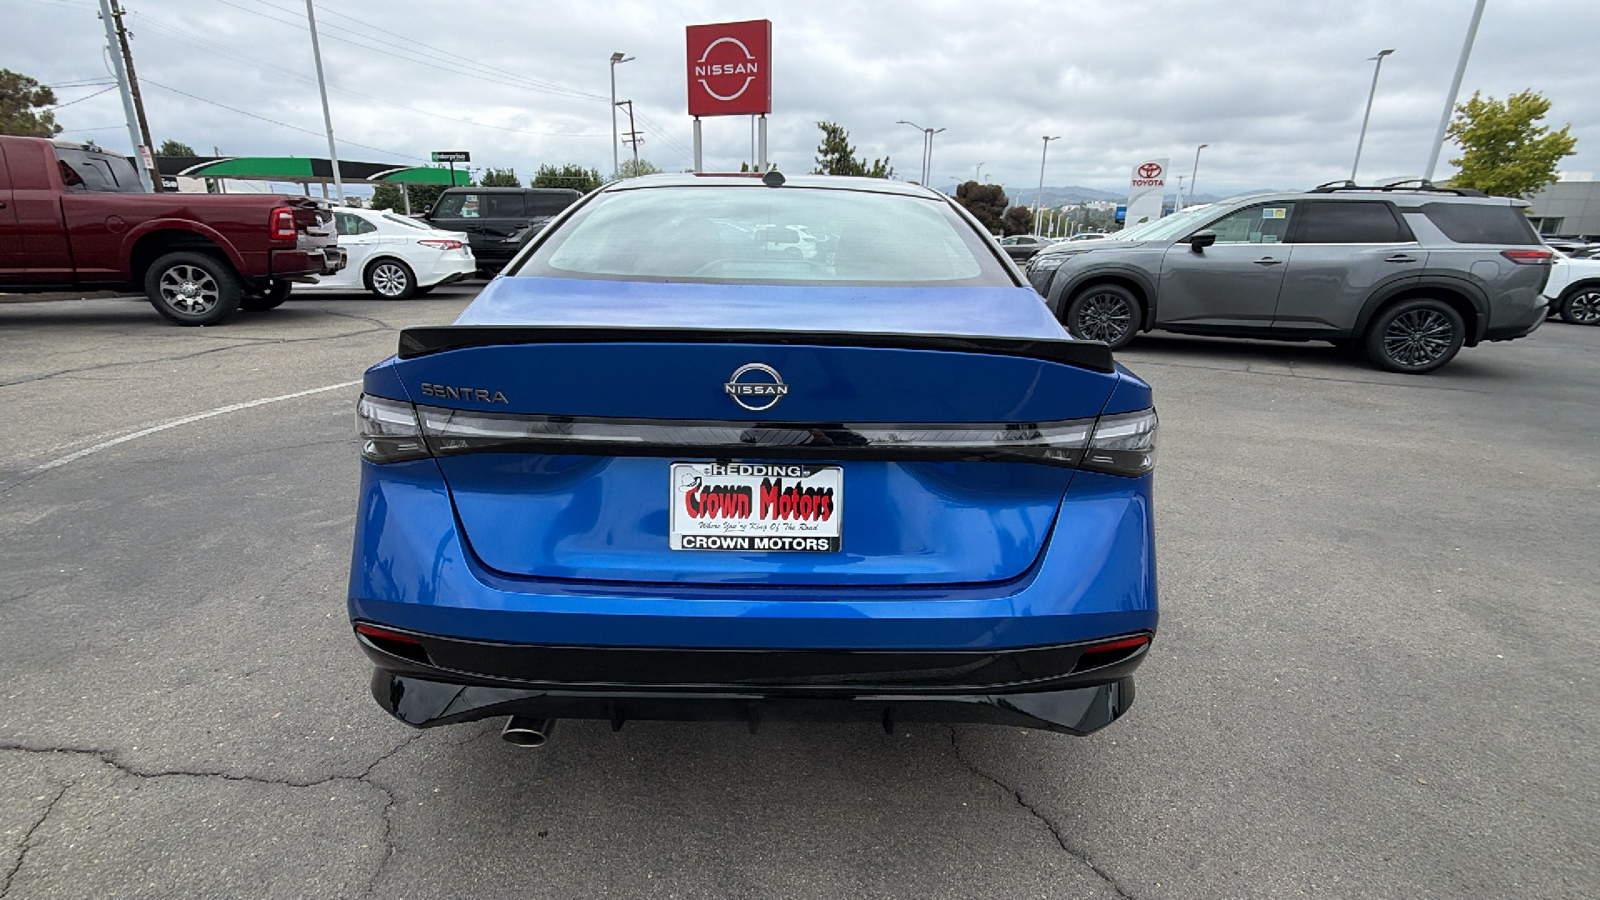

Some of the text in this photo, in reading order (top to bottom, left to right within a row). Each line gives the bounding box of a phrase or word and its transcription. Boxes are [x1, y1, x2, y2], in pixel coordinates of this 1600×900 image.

[695, 62, 758, 76] NISSAN
[1132, 179, 1164, 187] TOYOTA
[421, 382, 509, 404] SENTRA
[725, 384, 788, 394] NISSAN
[712, 464, 801, 477] REDDING
[685, 478, 833, 522] Crown Motors
[749, 522, 768, 532] King
[769, 523, 781, 532] Of
[782, 523, 796, 531] The
[798, 523, 819, 531] Road
[682, 536, 829, 551] CROWN MOTORS
